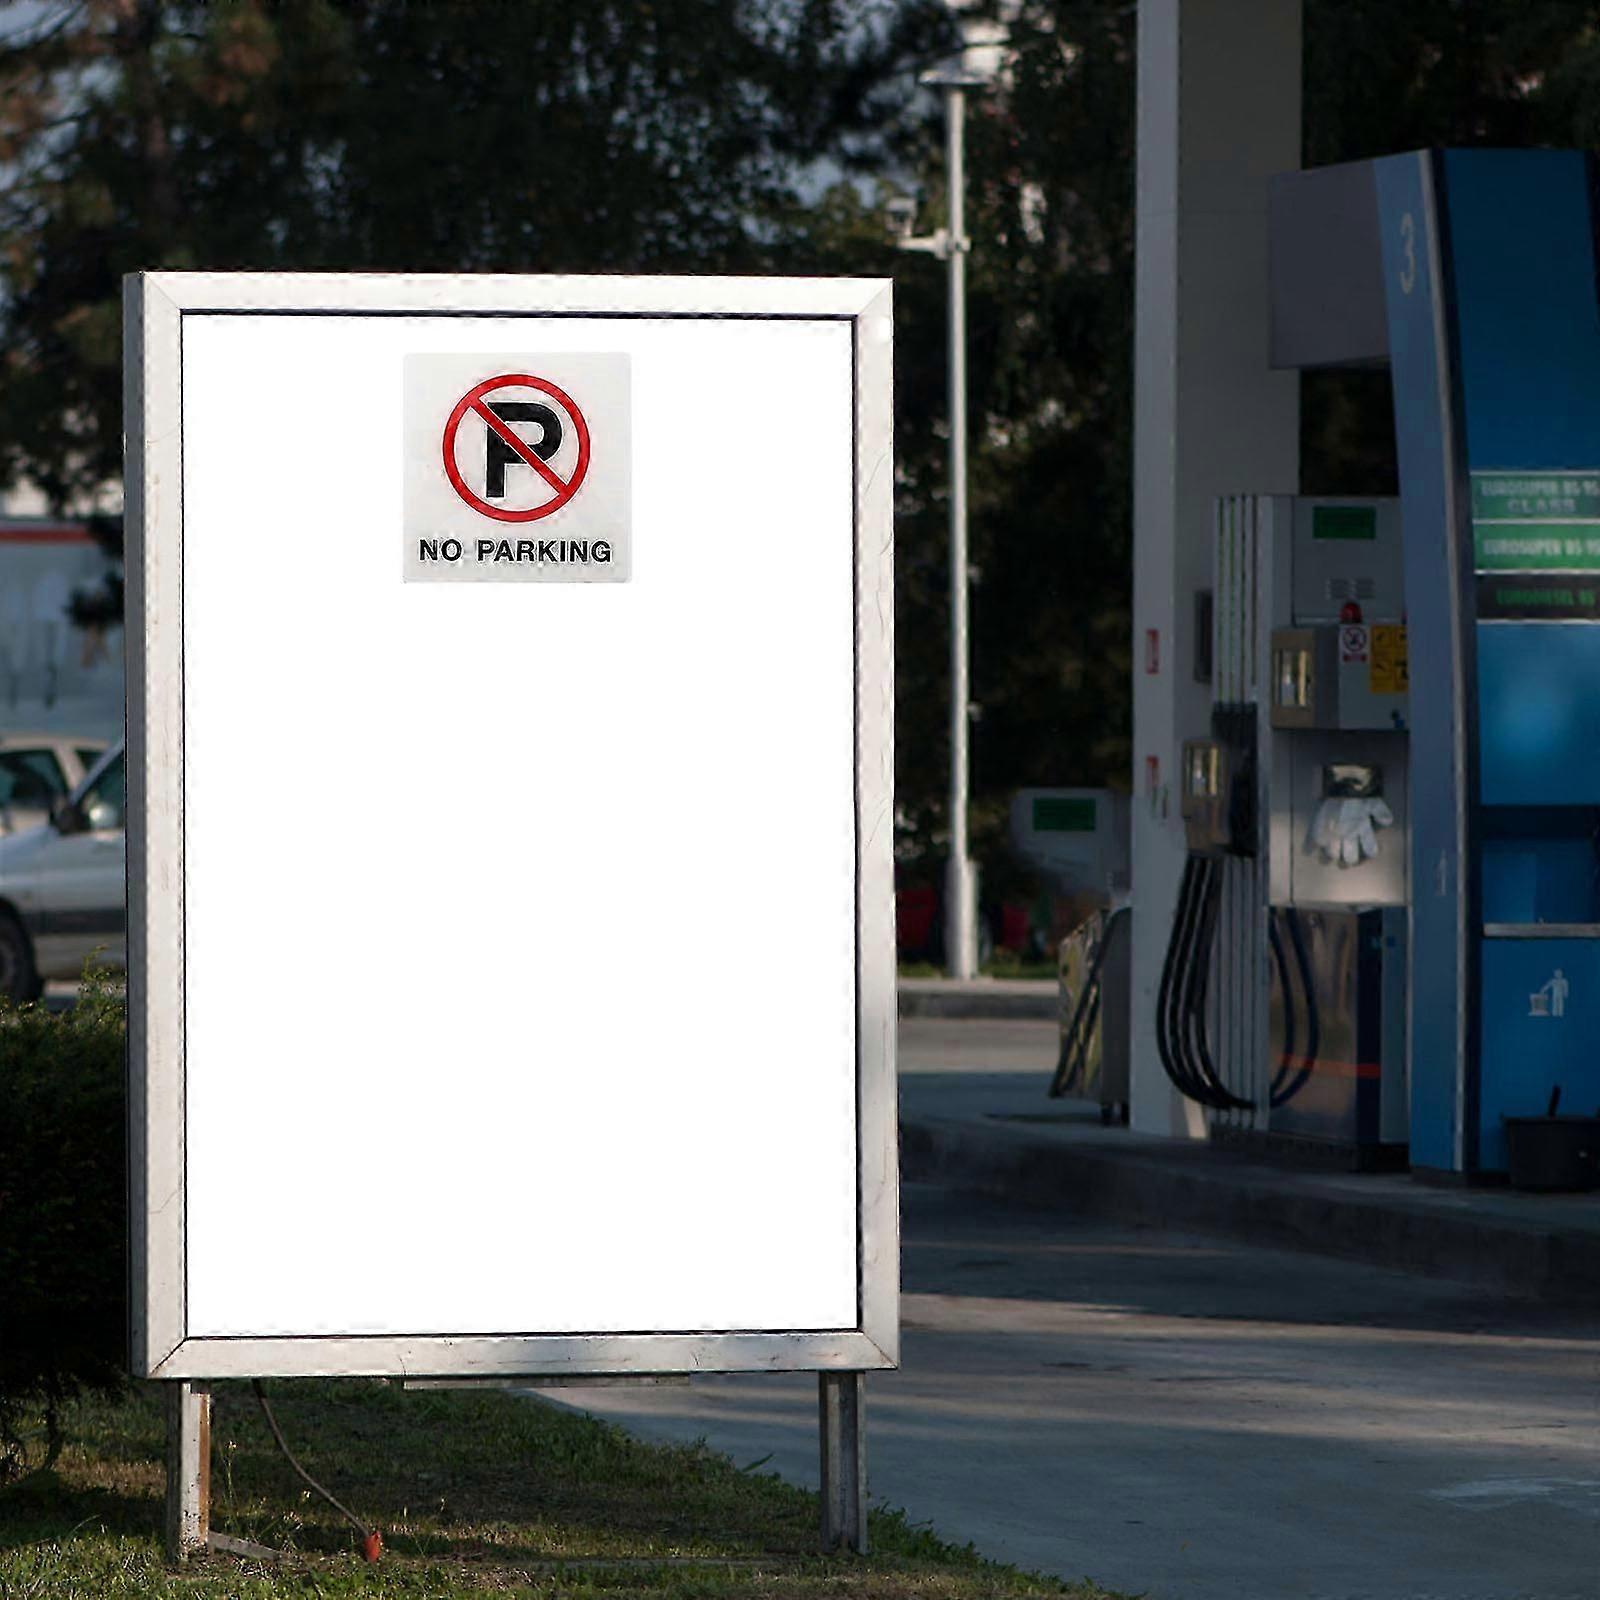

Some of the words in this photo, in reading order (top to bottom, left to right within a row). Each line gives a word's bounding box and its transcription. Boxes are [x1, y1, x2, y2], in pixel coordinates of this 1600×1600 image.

[1400, 212, 1416, 294] 3
[418, 538, 463, 562] NO
[477, 538, 612, 563] PARKING
